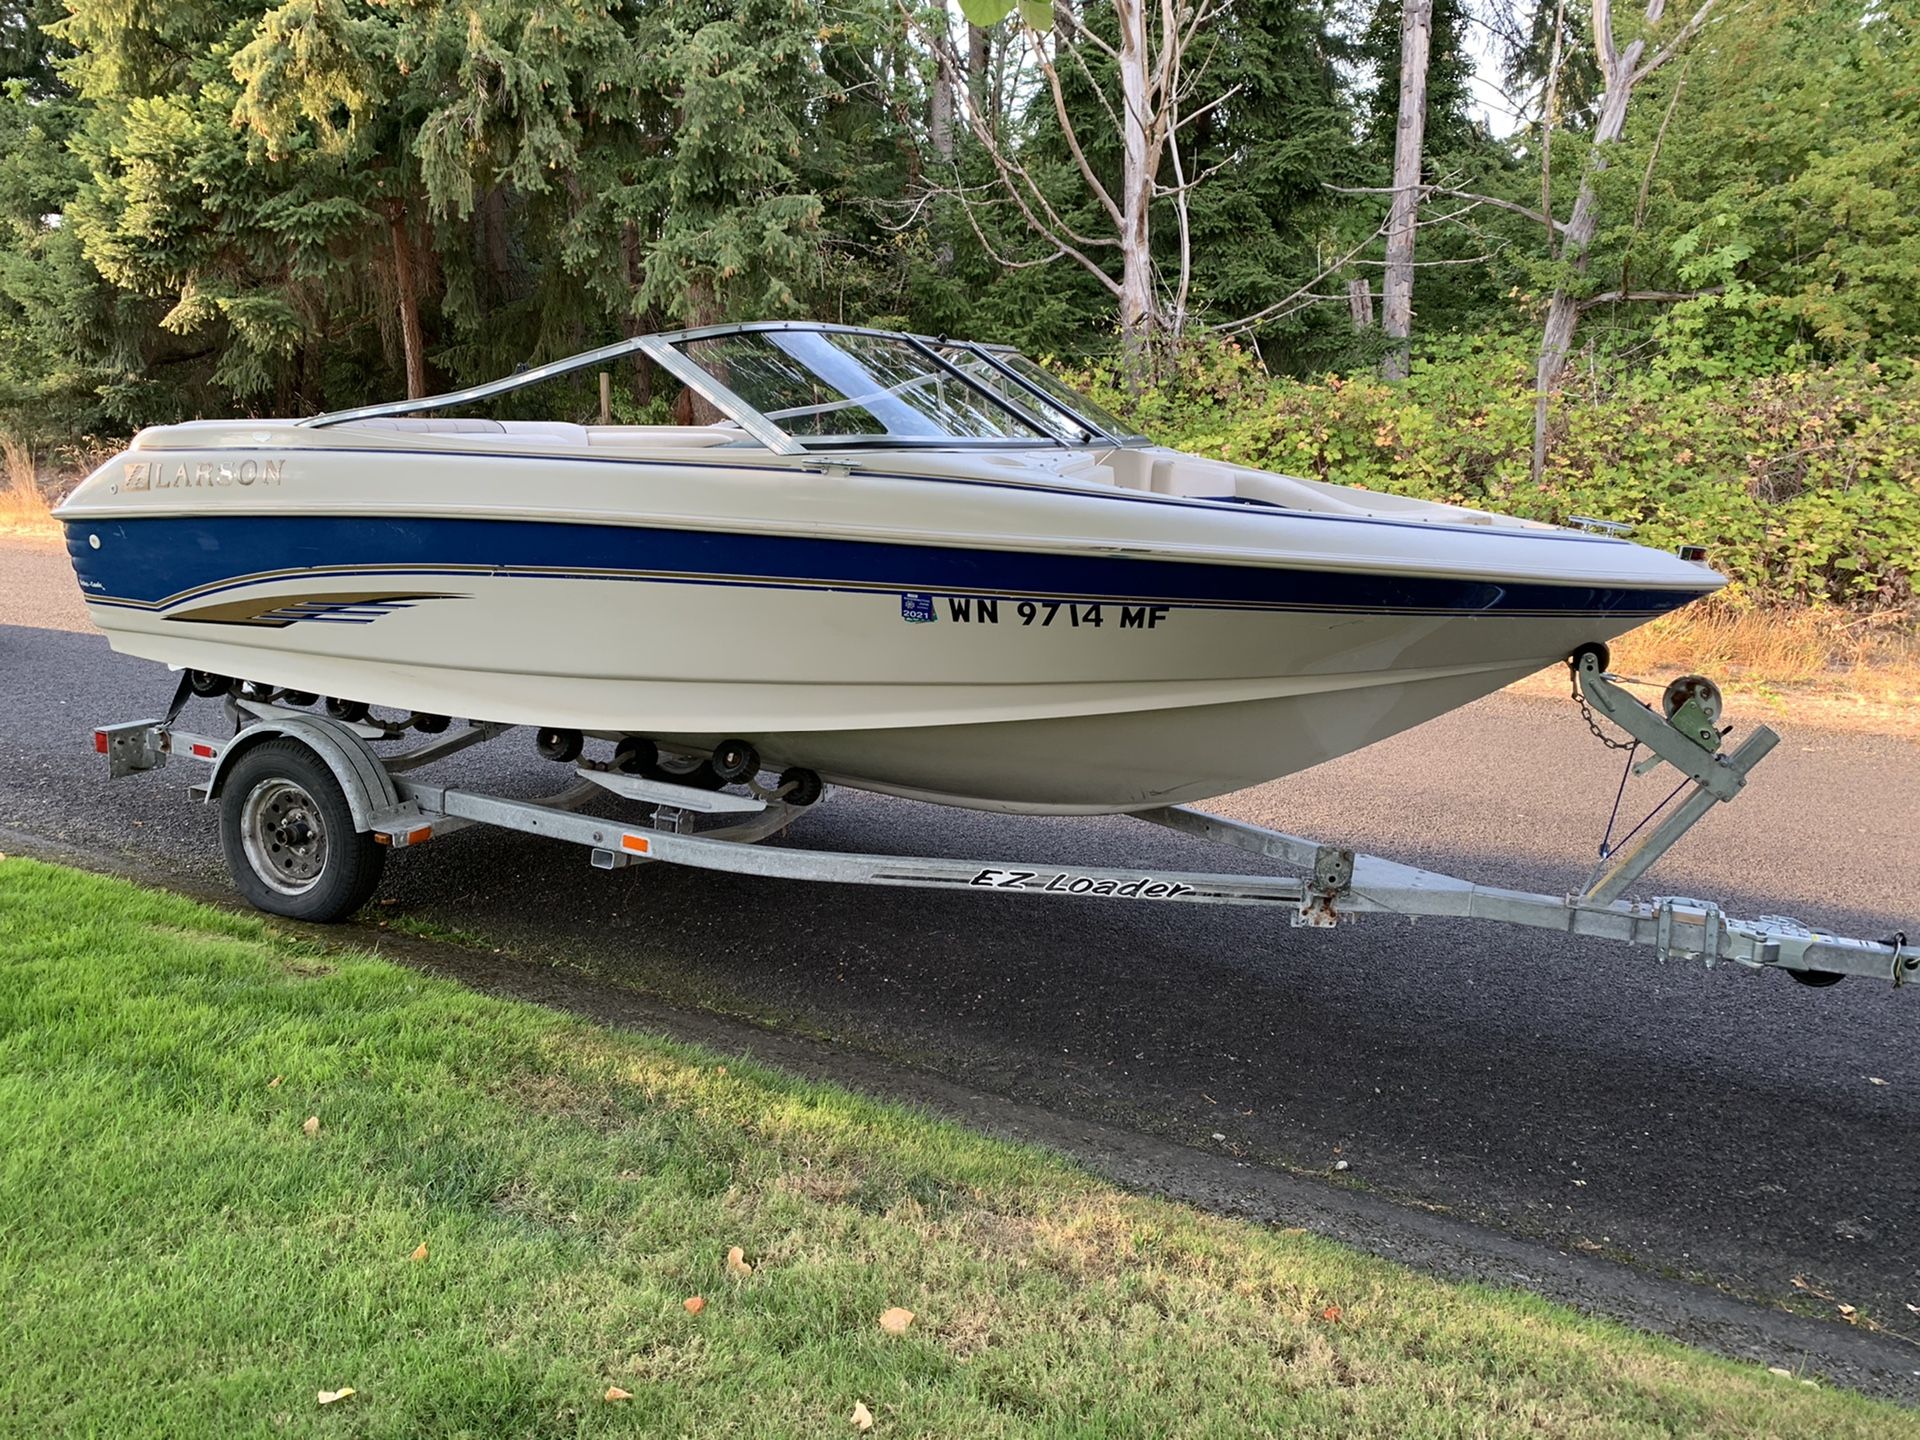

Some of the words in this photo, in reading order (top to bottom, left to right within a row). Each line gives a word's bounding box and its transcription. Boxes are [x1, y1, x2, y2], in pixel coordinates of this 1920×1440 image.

[155, 459, 286, 488] LARSON
[903, 609, 929, 619] 2021
[948, 598, 998, 624] WN
[1017, 602, 1103, 628] 9714
[1119, 606, 1170, 629] MF
[970, 869, 1037, 889] EZ
[1044, 873, 1194, 898] Loader
